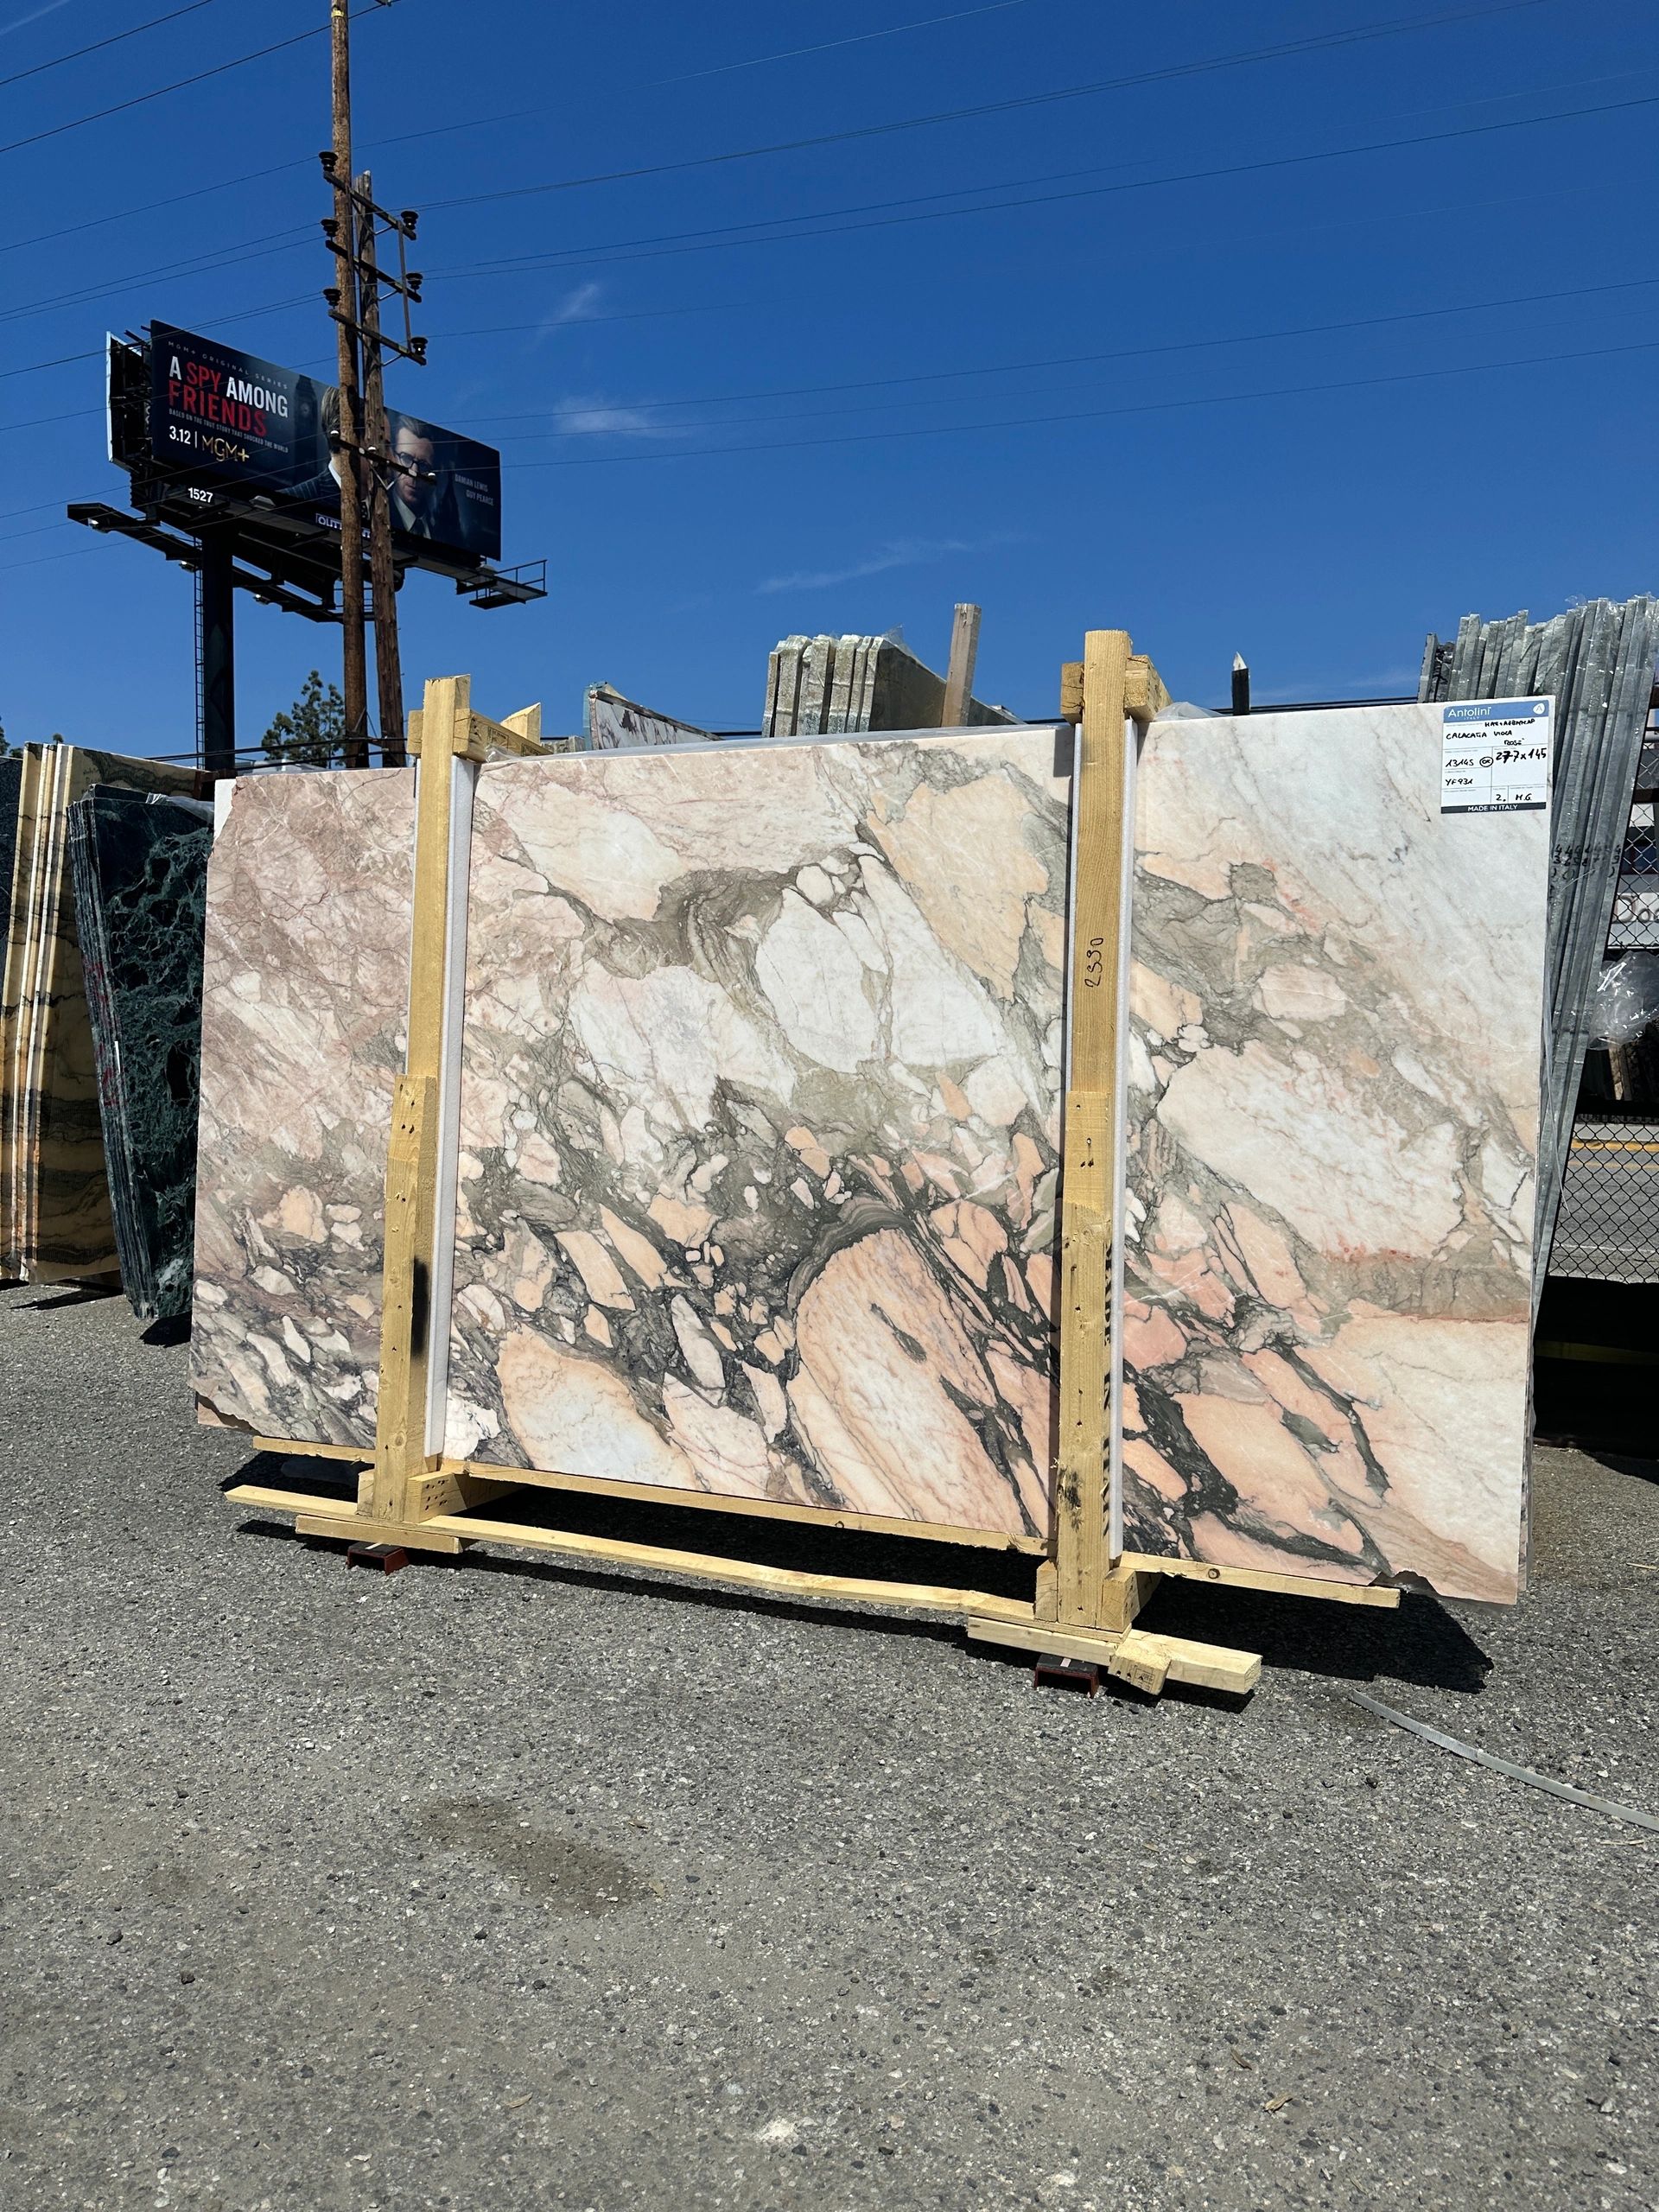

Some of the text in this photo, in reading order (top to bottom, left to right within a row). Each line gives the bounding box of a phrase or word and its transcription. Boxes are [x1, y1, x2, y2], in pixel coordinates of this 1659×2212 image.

[169, 356, 289, 418] A SPY AMONG
[202, 353, 250, 375] ORIGINAL
[256, 373, 288, 390] SERIES
[168, 380, 267, 437] FRIENDS
[168, 408, 289, 454] BASED ON THE TRUE STORY THAT SHOCKED THE WORLD
[168, 425, 250, 462] 3.12 MGM+
[188, 486, 213, 503] 1527
[1448, 706, 1492, 718] Antolini
